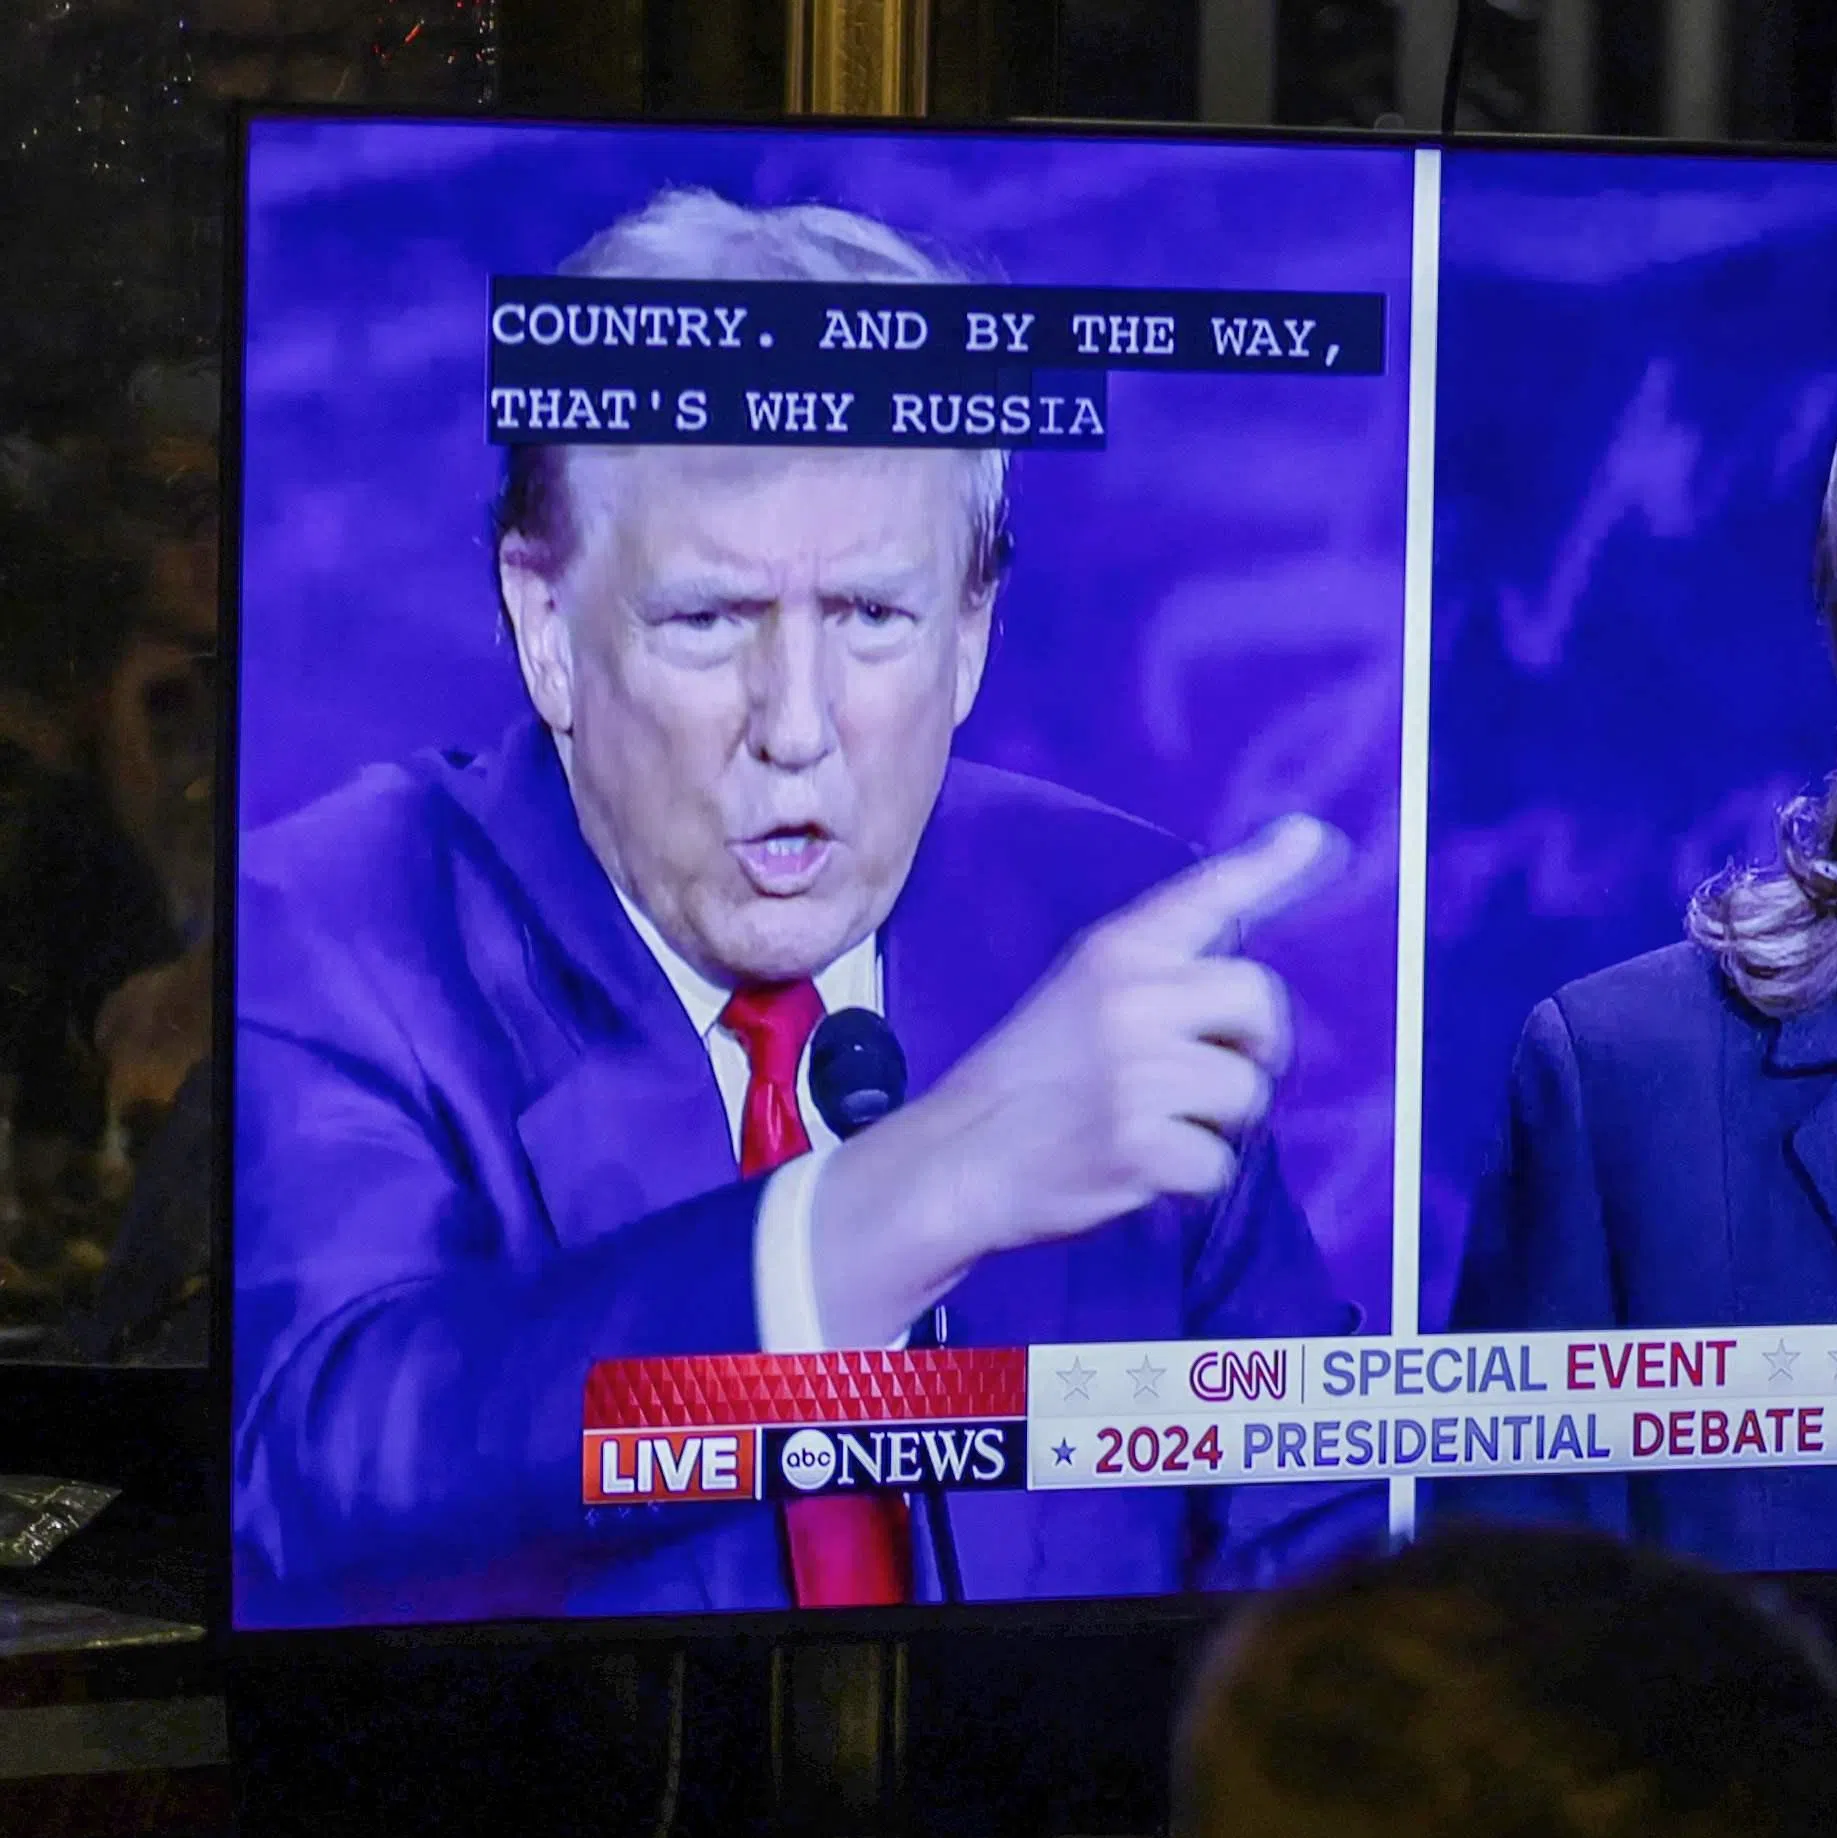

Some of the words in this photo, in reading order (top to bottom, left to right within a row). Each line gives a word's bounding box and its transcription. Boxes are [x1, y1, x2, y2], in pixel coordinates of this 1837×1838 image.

[491, 303, 774, 348] COUNTRY.
[819, 311, 928, 351] AND
[966, 312, 1036, 354] BY
[1073, 315, 1175, 356] THE
[1212, 317, 1343, 366] WAY,
[491, 389, 708, 431] THAT'S
[747, 392, 854, 433] WHY
[893, 394, 1105, 438] RUSSIA
[1190, 1350, 1286, 1401] CNN
[1323, 1345, 1546, 1397] SPECIAL
[1567, 1340, 1737, 1390] EVENT
[600, 1436, 739, 1495] LIVE
[785, 1444, 832, 1471] abc
[838, 1429, 1004, 1484] NEWS
[1096, 1426, 1223, 1475] 2024
[1243, 1413, 1610, 1470] PRESIDENTIAL
[1632, 1406, 1824, 1456] DEBATE
